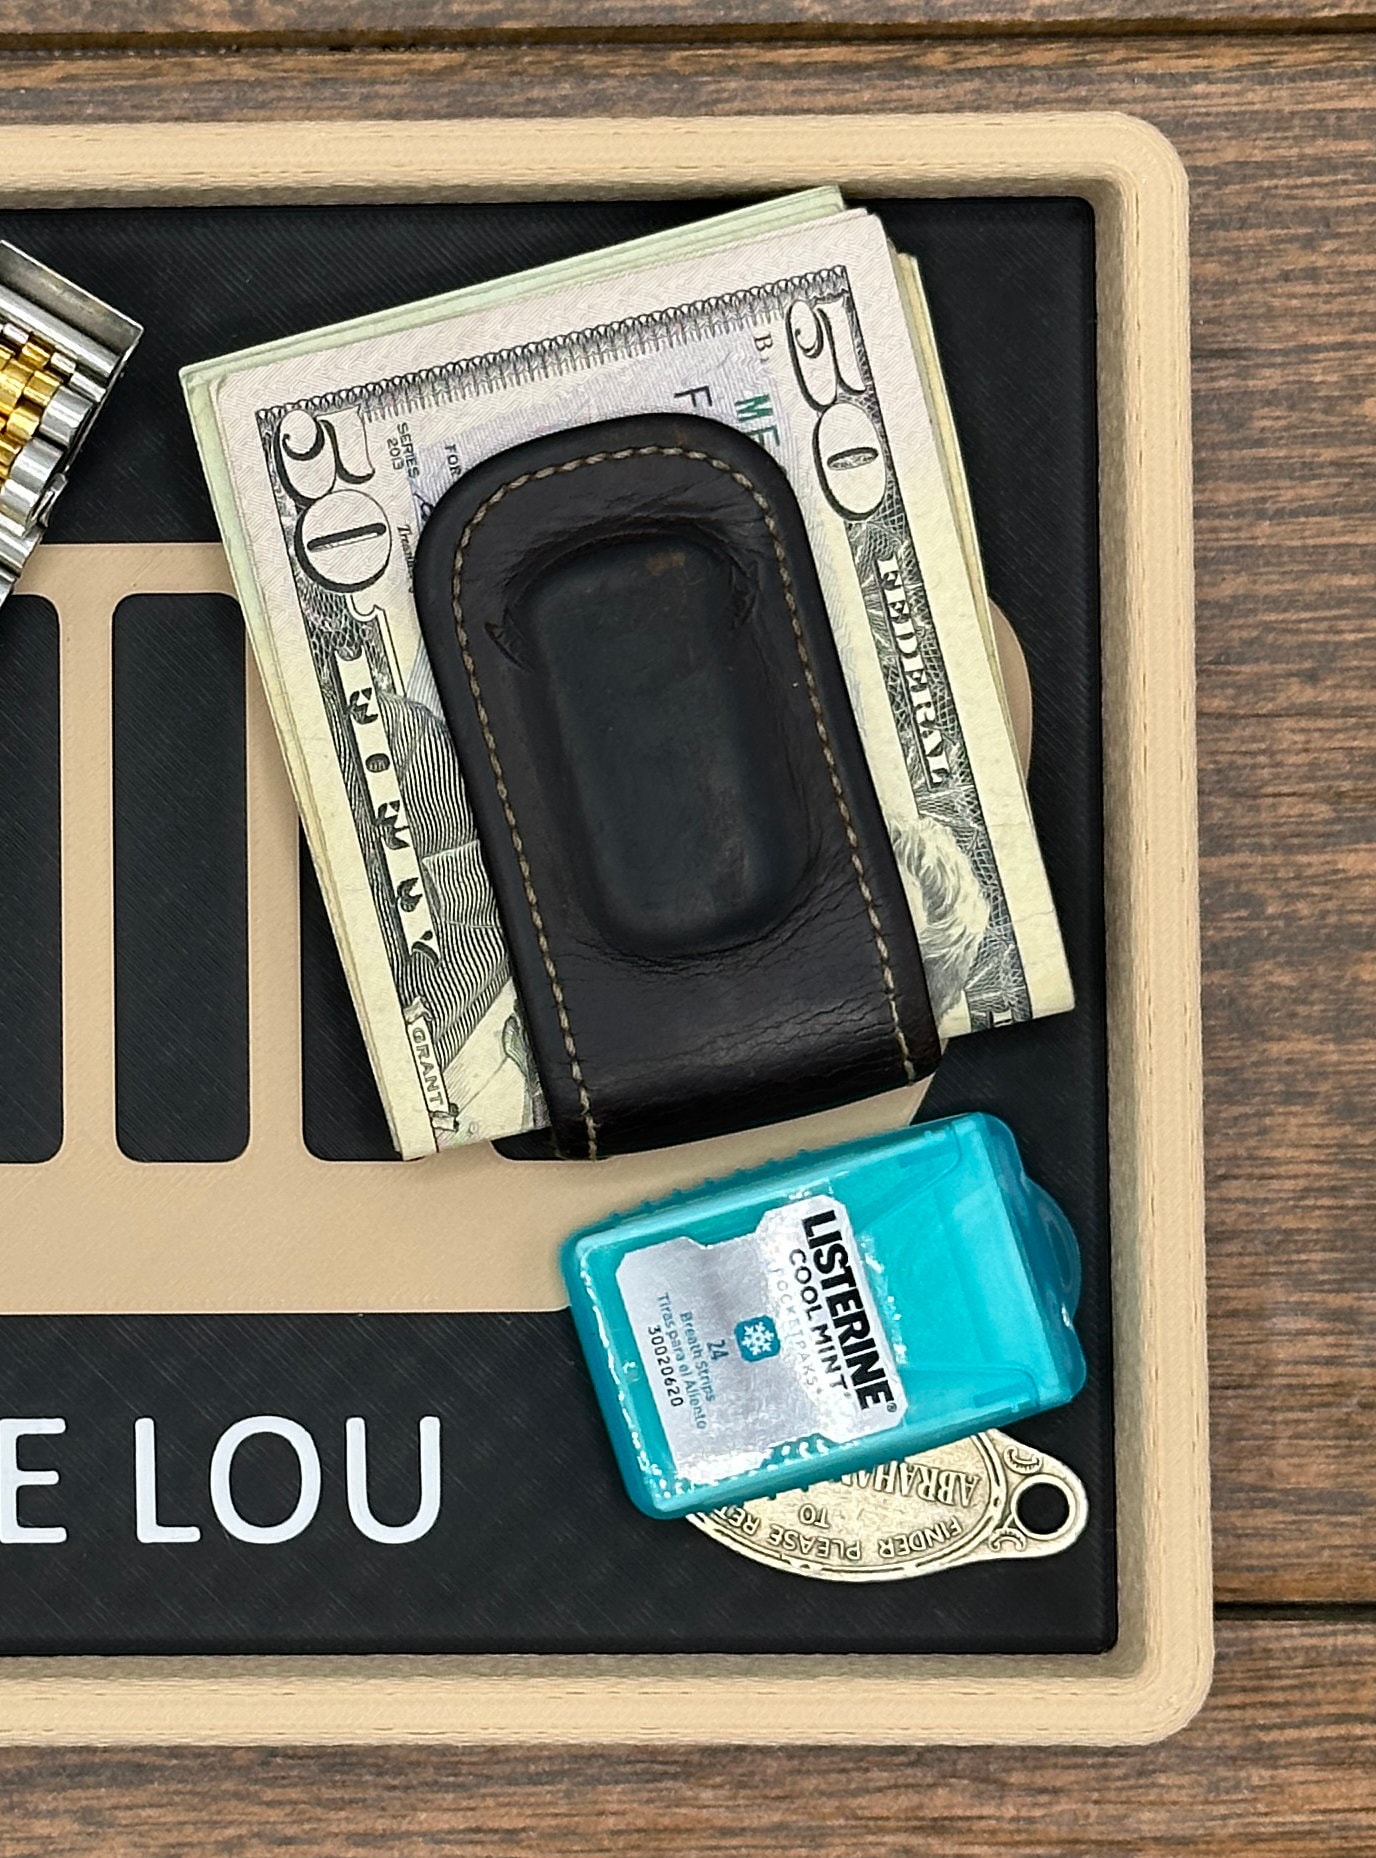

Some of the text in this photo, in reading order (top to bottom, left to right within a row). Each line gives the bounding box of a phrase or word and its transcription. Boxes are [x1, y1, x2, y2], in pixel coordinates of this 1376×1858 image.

[785, 298, 887, 521] 50
[387, 437, 405, 471] 2013
[397, 422, 420, 479] SERIES
[444, 443, 462, 477] FOR
[273, 405, 392, 593] 50
[876, 557, 951, 785] FEDERAL
[412, 1026, 446, 1107] GRANT
[657, 1292, 675, 1326] Tiras
[790, 1248, 822, 1321] COOL
[648, 1326, 684, 1407] 30020620
[665, 1328, 686, 1363] para
[679, 1311, 716, 1402] Breath Strips
[707, 1339, 729, 1361] 24
[134, 1414, 442, 1544] LOU
[841, 1460, 982, 1508] ABRAHA
[799, 1503, 831, 1528] TO
[879, 1515, 965, 1559] FINDER
[767, 1524, 862, 1562] PLEASE
